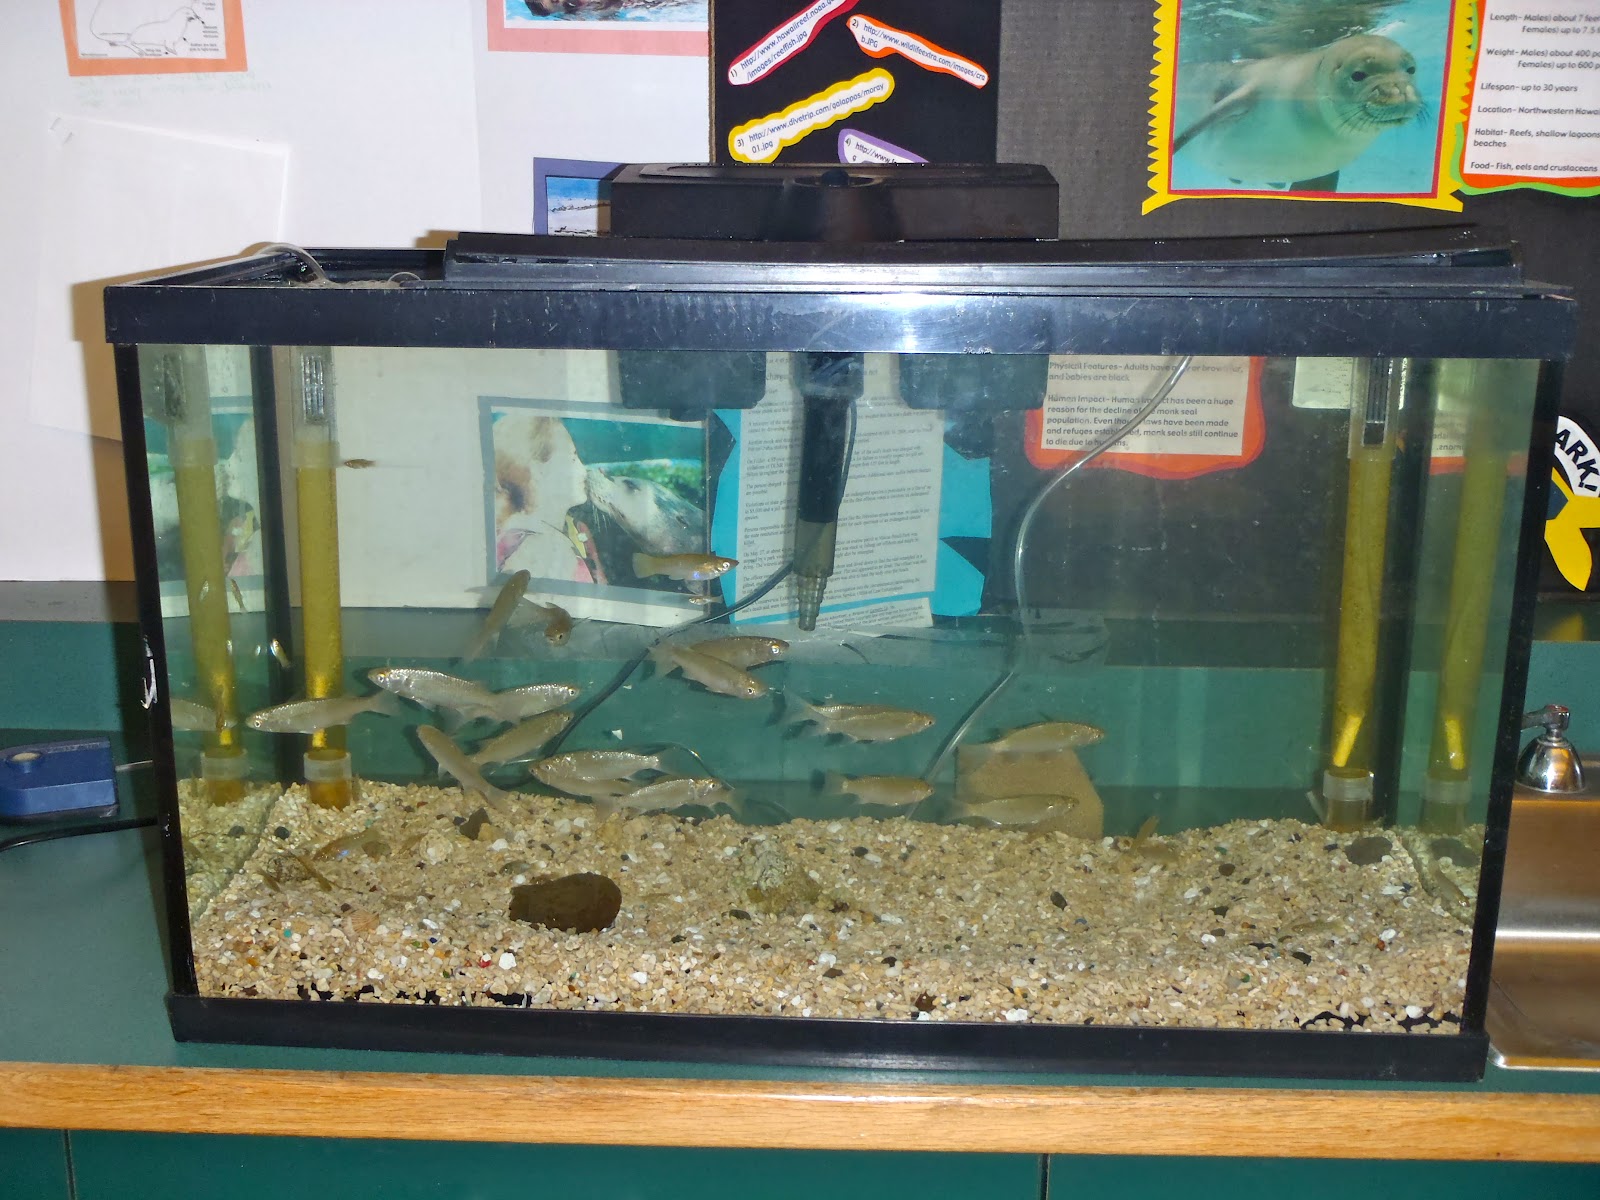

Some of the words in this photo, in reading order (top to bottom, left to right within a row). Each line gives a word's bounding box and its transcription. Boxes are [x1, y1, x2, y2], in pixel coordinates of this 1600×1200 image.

[1552, 14, 1577, 22] about
[852, 18, 859, 29] 2)
[1561, 27, 1571, 35] up
[1572, 26, 1580, 34] to
[730, 69, 738, 78] 1)
[740, 0, 834, 70] http://www.hawaiireef.noaa.g
[1549, 49, 1573, 57] about
[1575, 49, 1591, 57] 400
[1556, 62, 1567, 70] up
[1568, 61, 1576, 69] to
[1578, 61, 1593, 69] 600
[1521, 84, 1532, 92] up
[1543, 83, 1553, 91] 30
[1555, 85, 1578, 93] years
[1518, 107, 1574, 115] Northwestern
[1509, 128, 1533, 138] Reefs,
[1535, 129, 1567, 138] shallow
[736, 138, 744, 147] 3)
[751, 139, 774, 154] 01.jpg
[1473, 139, 1507, 147] beaches
[1495, 162, 1514, 171] Fish,
[1515, 163, 1532, 171] eels
[1533, 163, 1549, 171] and
[1549, 164, 1598, 173] crustaceans
[1049, 362, 1082, 371] Physical
[1123, 363, 1149, 371] Adults
[1150, 363, 1171, 371] have
[1202, 364, 1225, 372] brow
[1048, 373, 1064, 381] and
[1065, 373, 1091, 381] babies
[1047, 394, 1077, 403] Human
[1170, 397, 1185, 405] has
[1213, 398, 1234, 406] huge
[1047, 406, 1075, 414] reason
[1076, 406, 1088, 414] for
[1089, 406, 1102, 414] the
[1180, 408, 1198, 416] seal
[1046, 417, 1092, 425] population.
[1093, 417, 1113, 425] Even
[1184, 419, 1203, 427] been
[1205, 419, 1229, 427] made
[1062, 427, 1093, 436] refuges
[1143, 429, 1166, 437] monk
[1167, 429, 1188, 437] seals
[1188, 429, 1203, 437] still
[1204, 430, 1239, 438] continue
[1055, 438, 1068, 446] die
[1068, 438, 1084, 446] due
